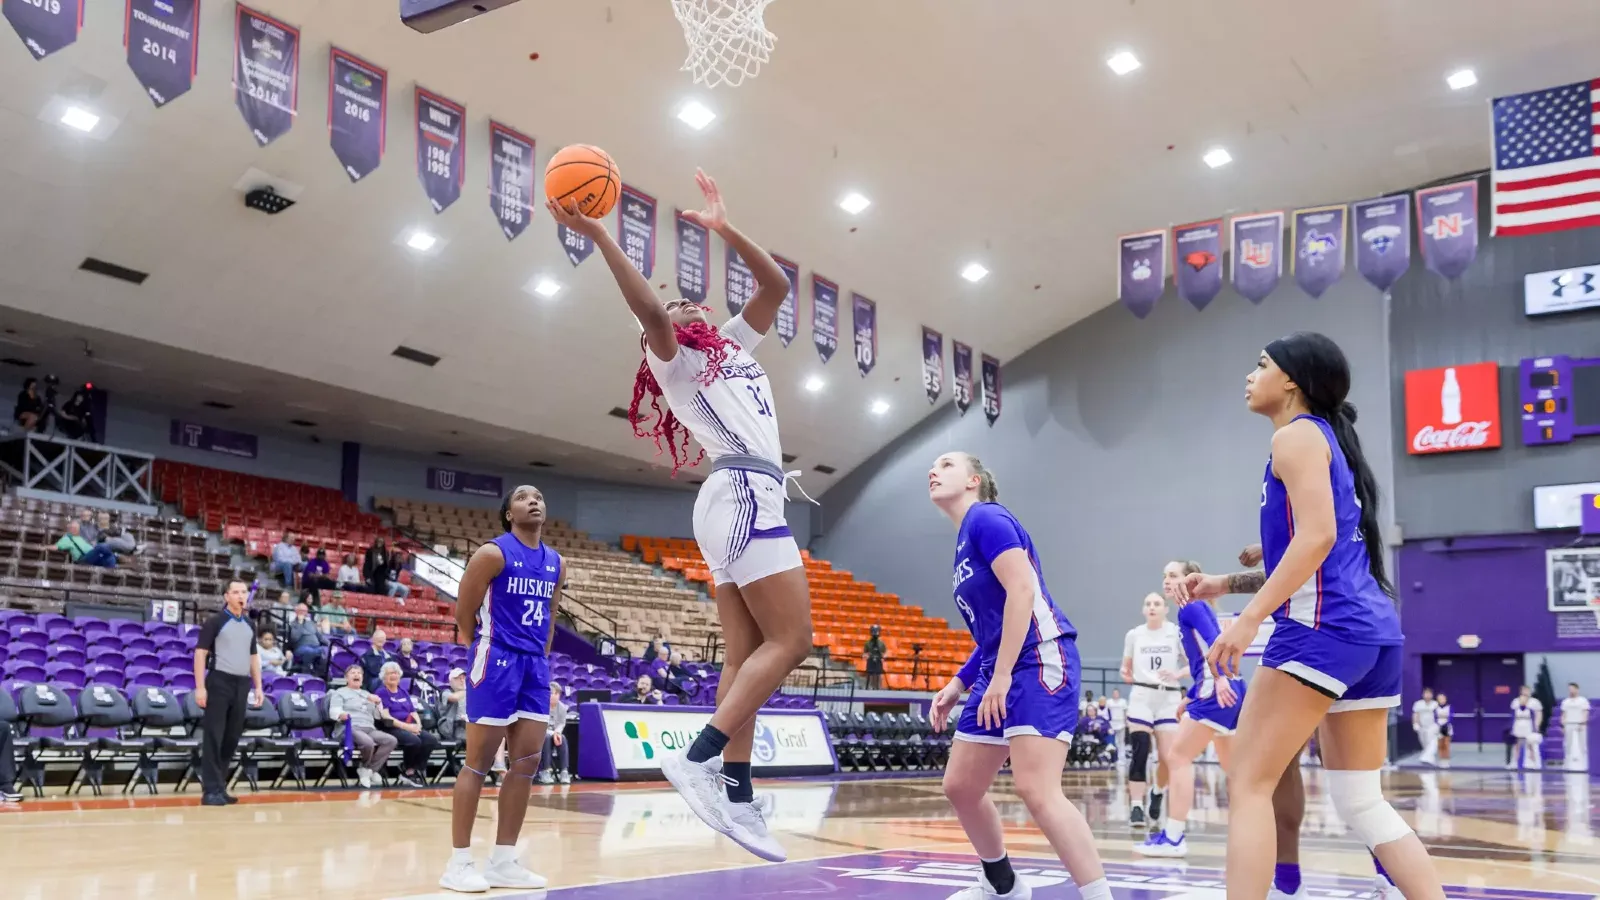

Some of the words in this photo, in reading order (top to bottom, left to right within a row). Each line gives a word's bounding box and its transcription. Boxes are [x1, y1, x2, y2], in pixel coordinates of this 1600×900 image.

[21, 0, 61, 15] 019
[133, 8, 191, 40] TOURNAMENT
[142, 37, 177, 64] 2014
[248, 82, 279, 104] 2014
[344, 100, 371, 122] 2016
[427, 145, 451, 165] 1986
[427, 158, 451, 178] 1995
[500, 206, 522, 224] 1999
[1434, 214, 1462, 239] N
[565, 233, 586, 251] 2015
[856, 344, 873, 366] 10
[924, 373, 940, 392] 25
[954, 385, 970, 404] 33
[984, 398, 999, 416] 45
[185, 424, 203, 447] T
[1413, 421, 1491, 450] Coca-Cola
[439, 468, 456, 490] U
[521, 599, 545, 627] 24
[1150, 656, 1162, 670] 19
[776, 727, 807, 748] Graf
